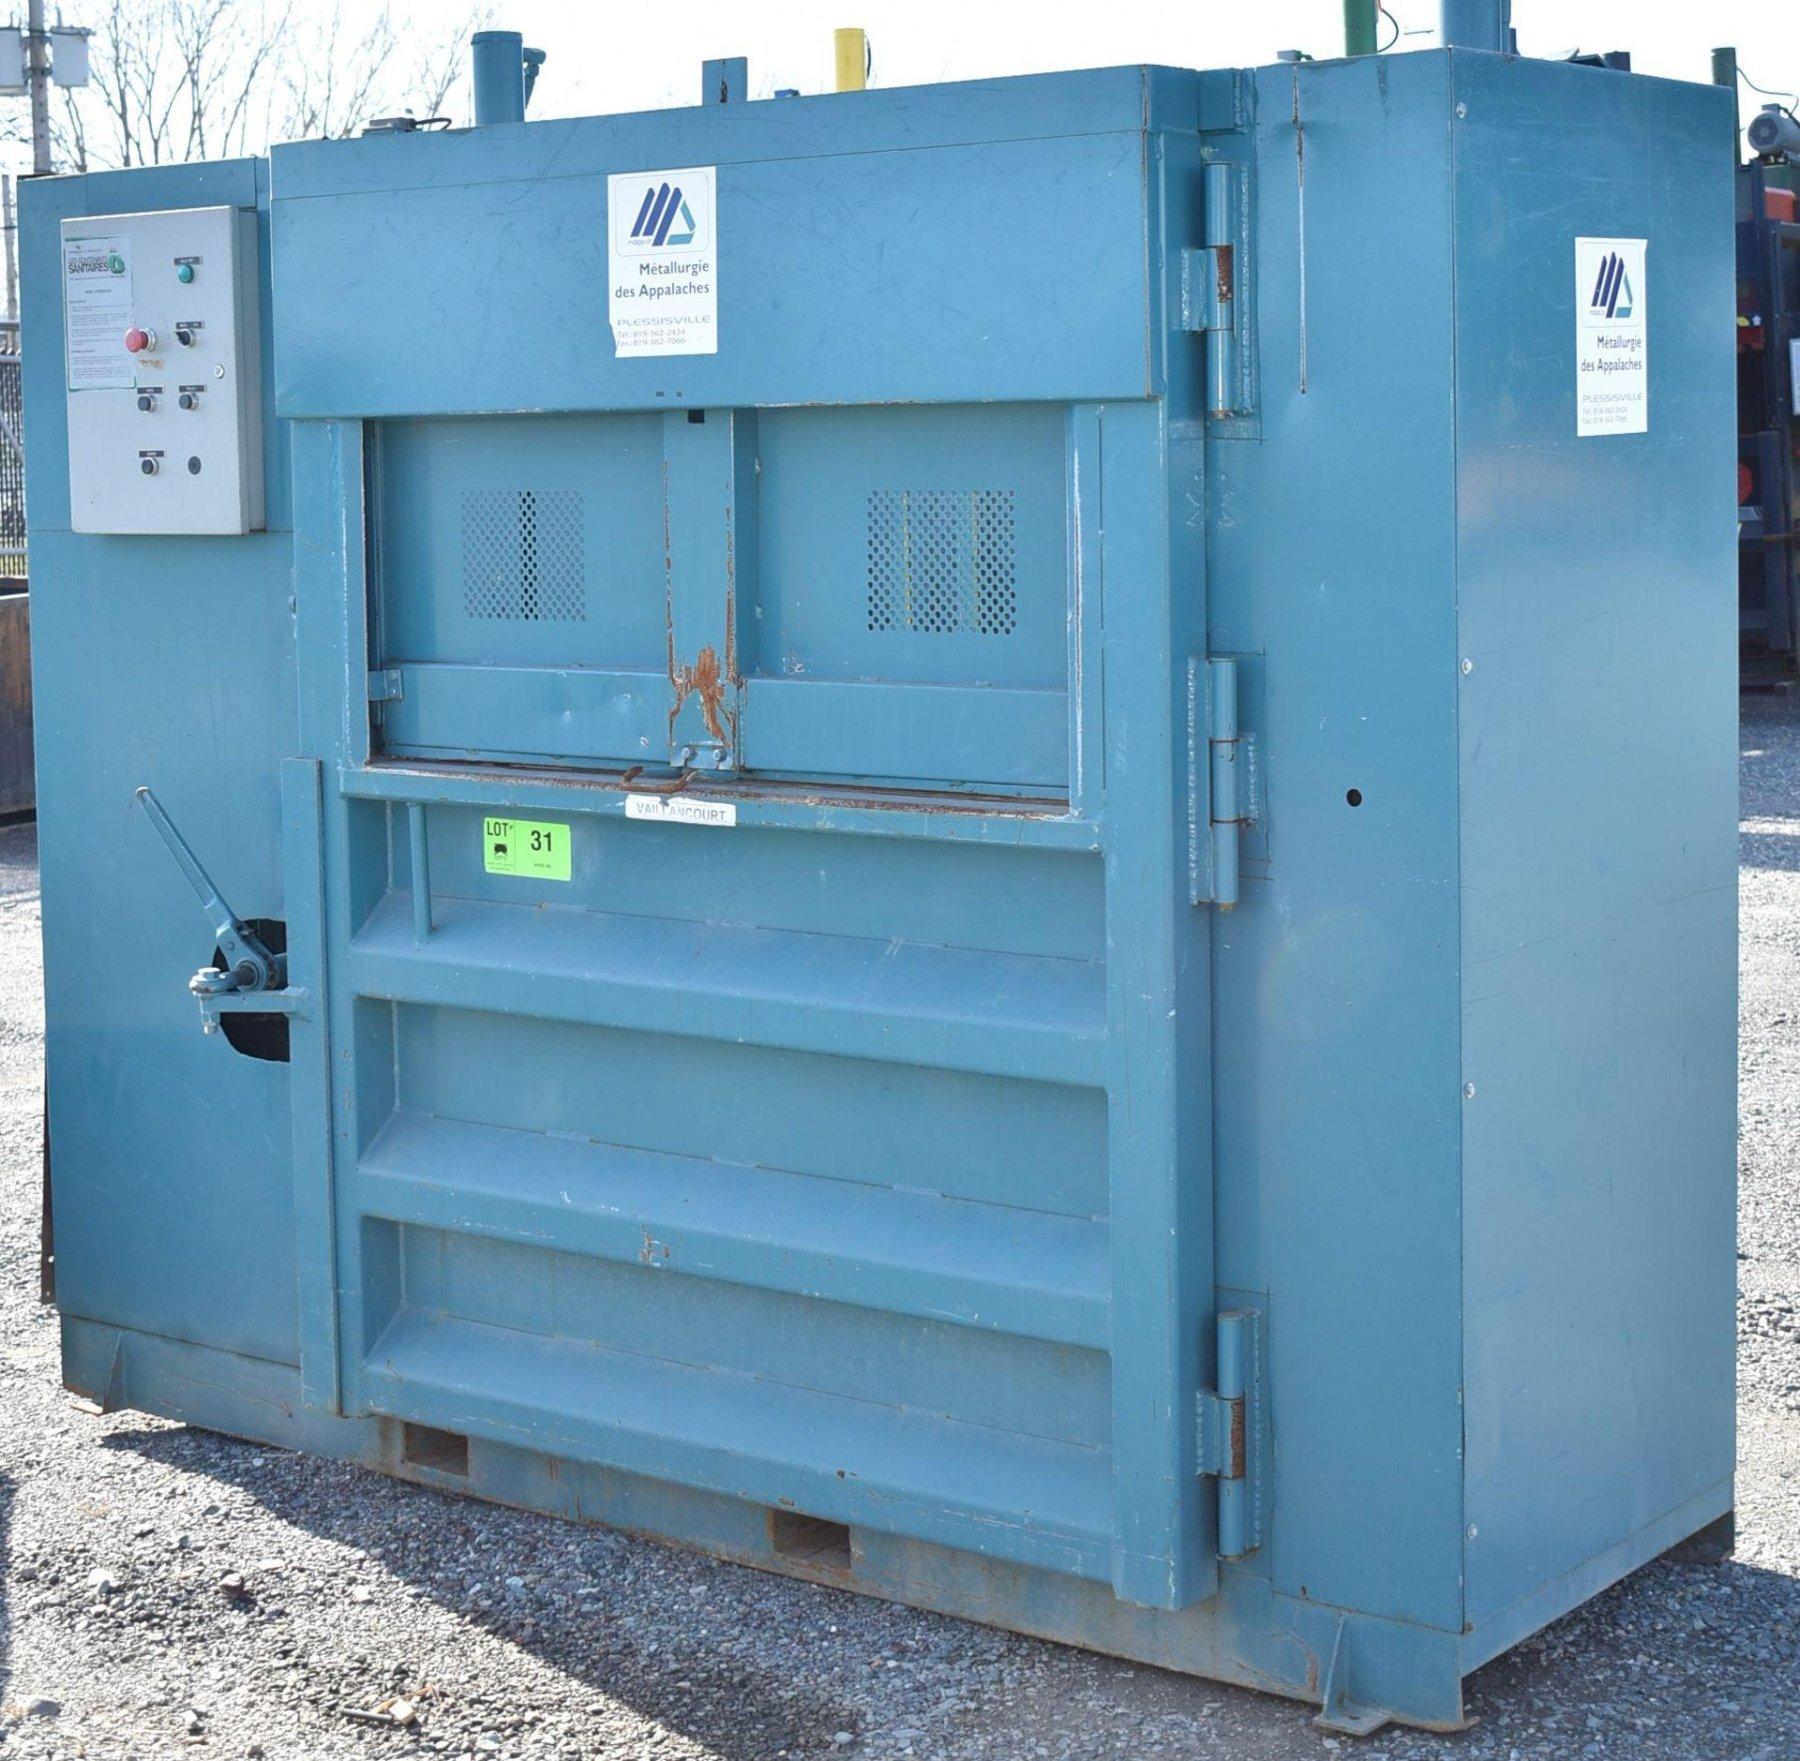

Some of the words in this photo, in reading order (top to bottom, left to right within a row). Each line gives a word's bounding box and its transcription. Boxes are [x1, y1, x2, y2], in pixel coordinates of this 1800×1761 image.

[68, 262, 109, 273] SANITAIRES
[639, 260, 709, 276] Métallurgie
[615, 286, 635, 298] des
[638, 281, 710, 300] Appalaches
[617, 315, 711, 327] PLESSISVILLE
[1597, 335, 1642, 352] Métallurgie
[1581, 358, 1595, 372] des
[1597, 357, 1642, 375] Appalaches
[1582, 393, 1643, 403] PLESSISVILLE
[531, 830, 552, 852] 31
